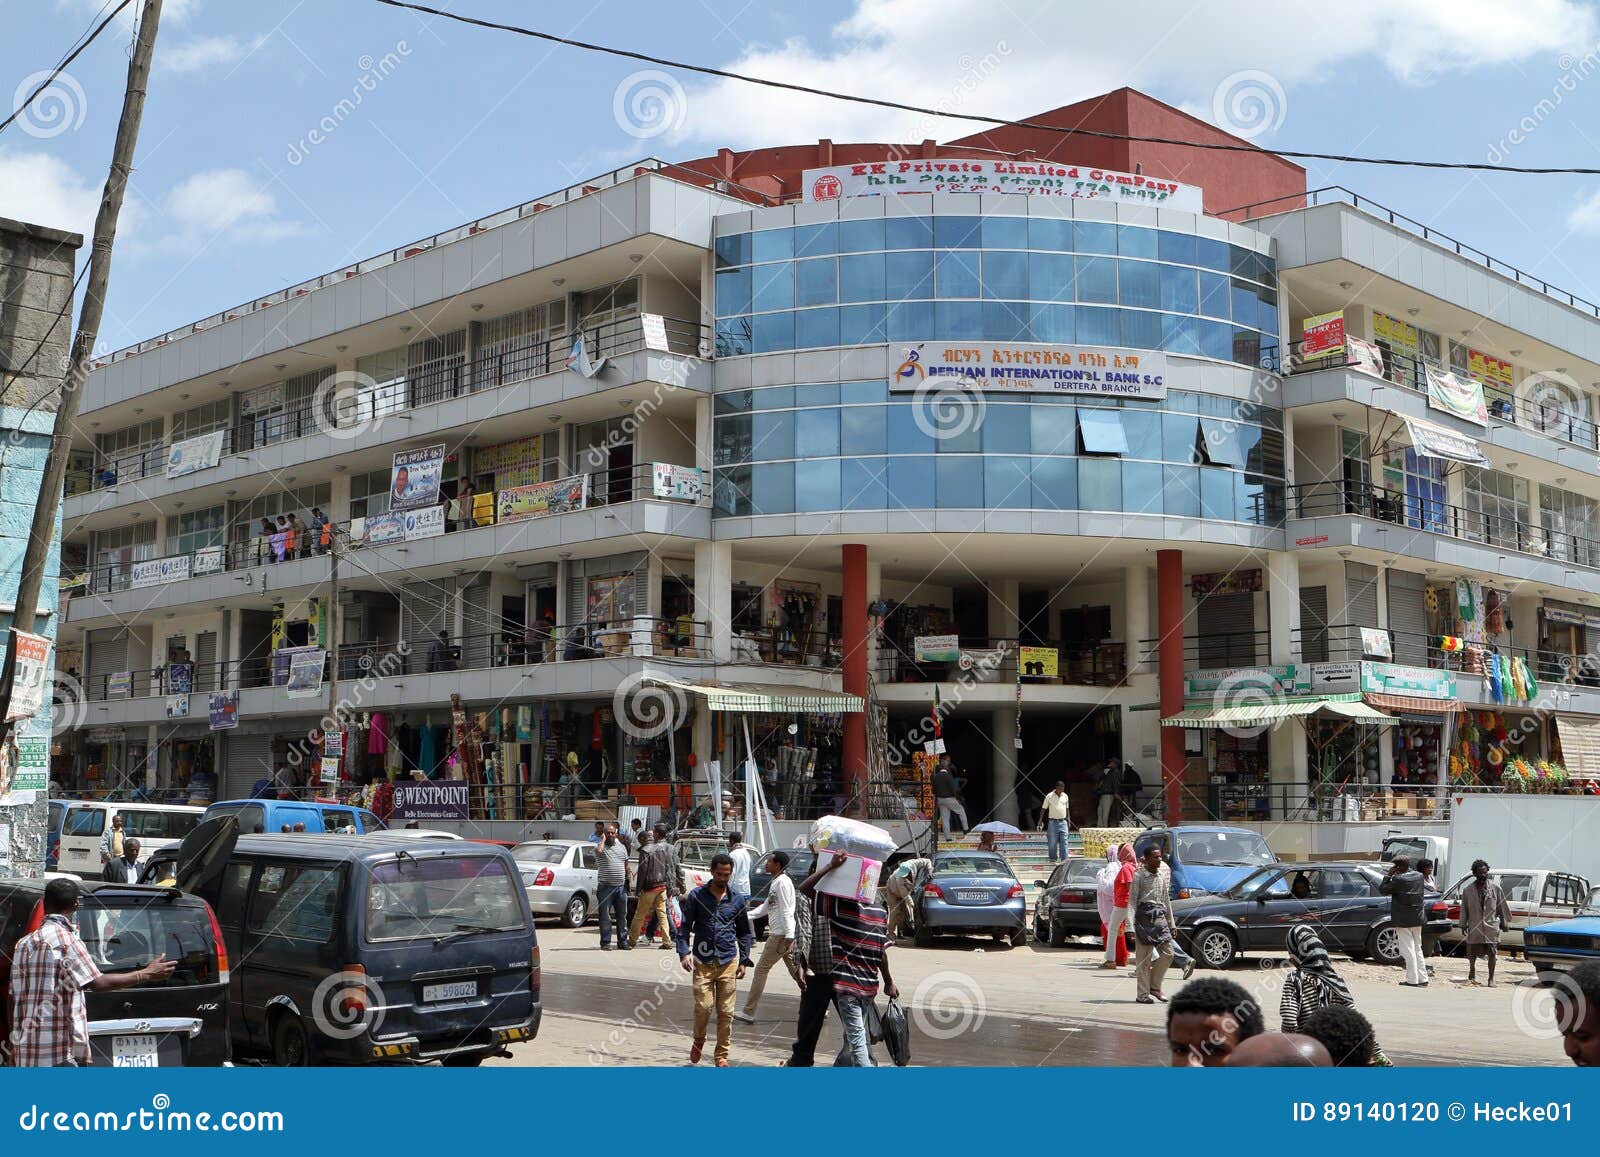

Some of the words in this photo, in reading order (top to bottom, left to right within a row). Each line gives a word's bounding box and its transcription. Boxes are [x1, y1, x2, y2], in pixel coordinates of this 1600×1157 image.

[851, 164, 886, 176] KK
[898, 161, 982, 174] Private
[994, 162, 1080, 179] Limited
[1078, 353, 1107, 367] ባንክ
[928, 366, 986, 378] BERHAN
[1105, 372, 1140, 384] BANK
[1143, 375, 1163, 386] S.C
[1053, 381, 1097, 391] DERTERA
[1101, 383, 1141, 393] BRANCH
[405, 786, 469, 805] WESTPOINT
